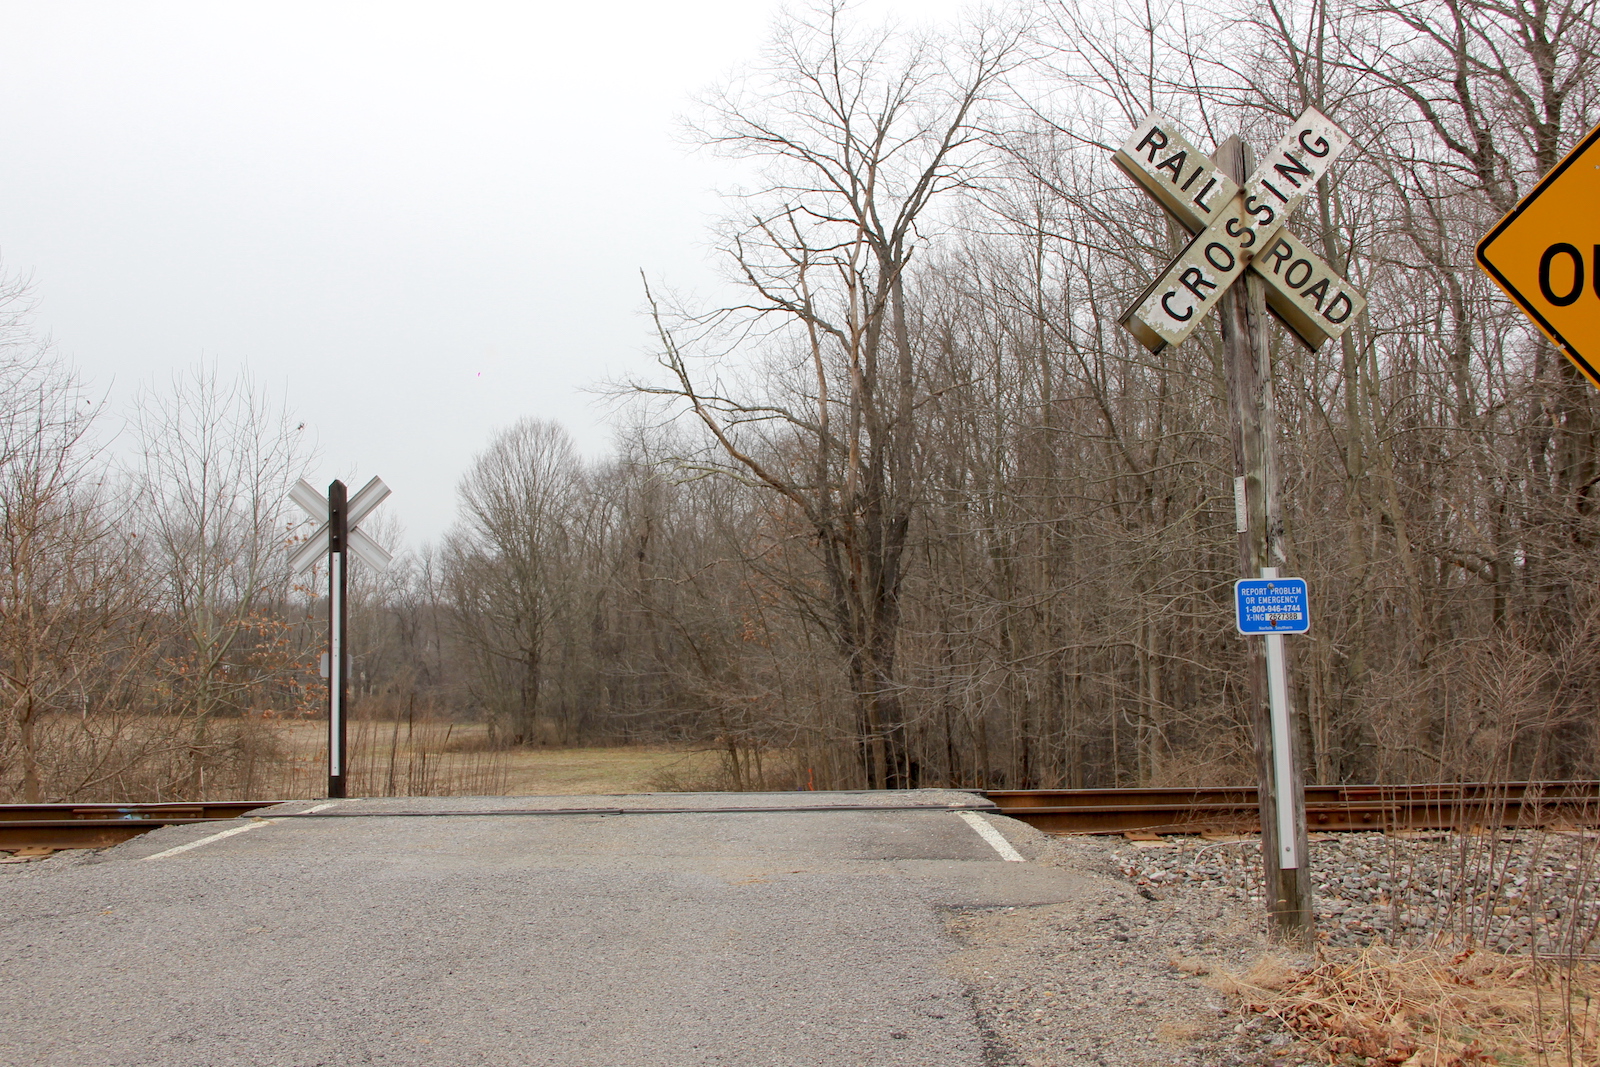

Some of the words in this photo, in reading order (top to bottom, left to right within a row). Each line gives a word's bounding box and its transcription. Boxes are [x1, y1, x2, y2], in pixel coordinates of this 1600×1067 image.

[1135, 125, 1218, 214] RAIL
[1261, 237, 1353, 325] ROAD
[1161, 129, 1330, 322] CROSSING
[1538, 242, 1600, 307] O
[1241, 587, 1267, 596] REPORT
[1270, 587, 1302, 595] PROBLEM
[1258, 596, 1298, 604] EMERGENCY
[1245, 605, 1301, 613] 1-800-946-4744
[1246, 613, 1265, 621] X-ING
